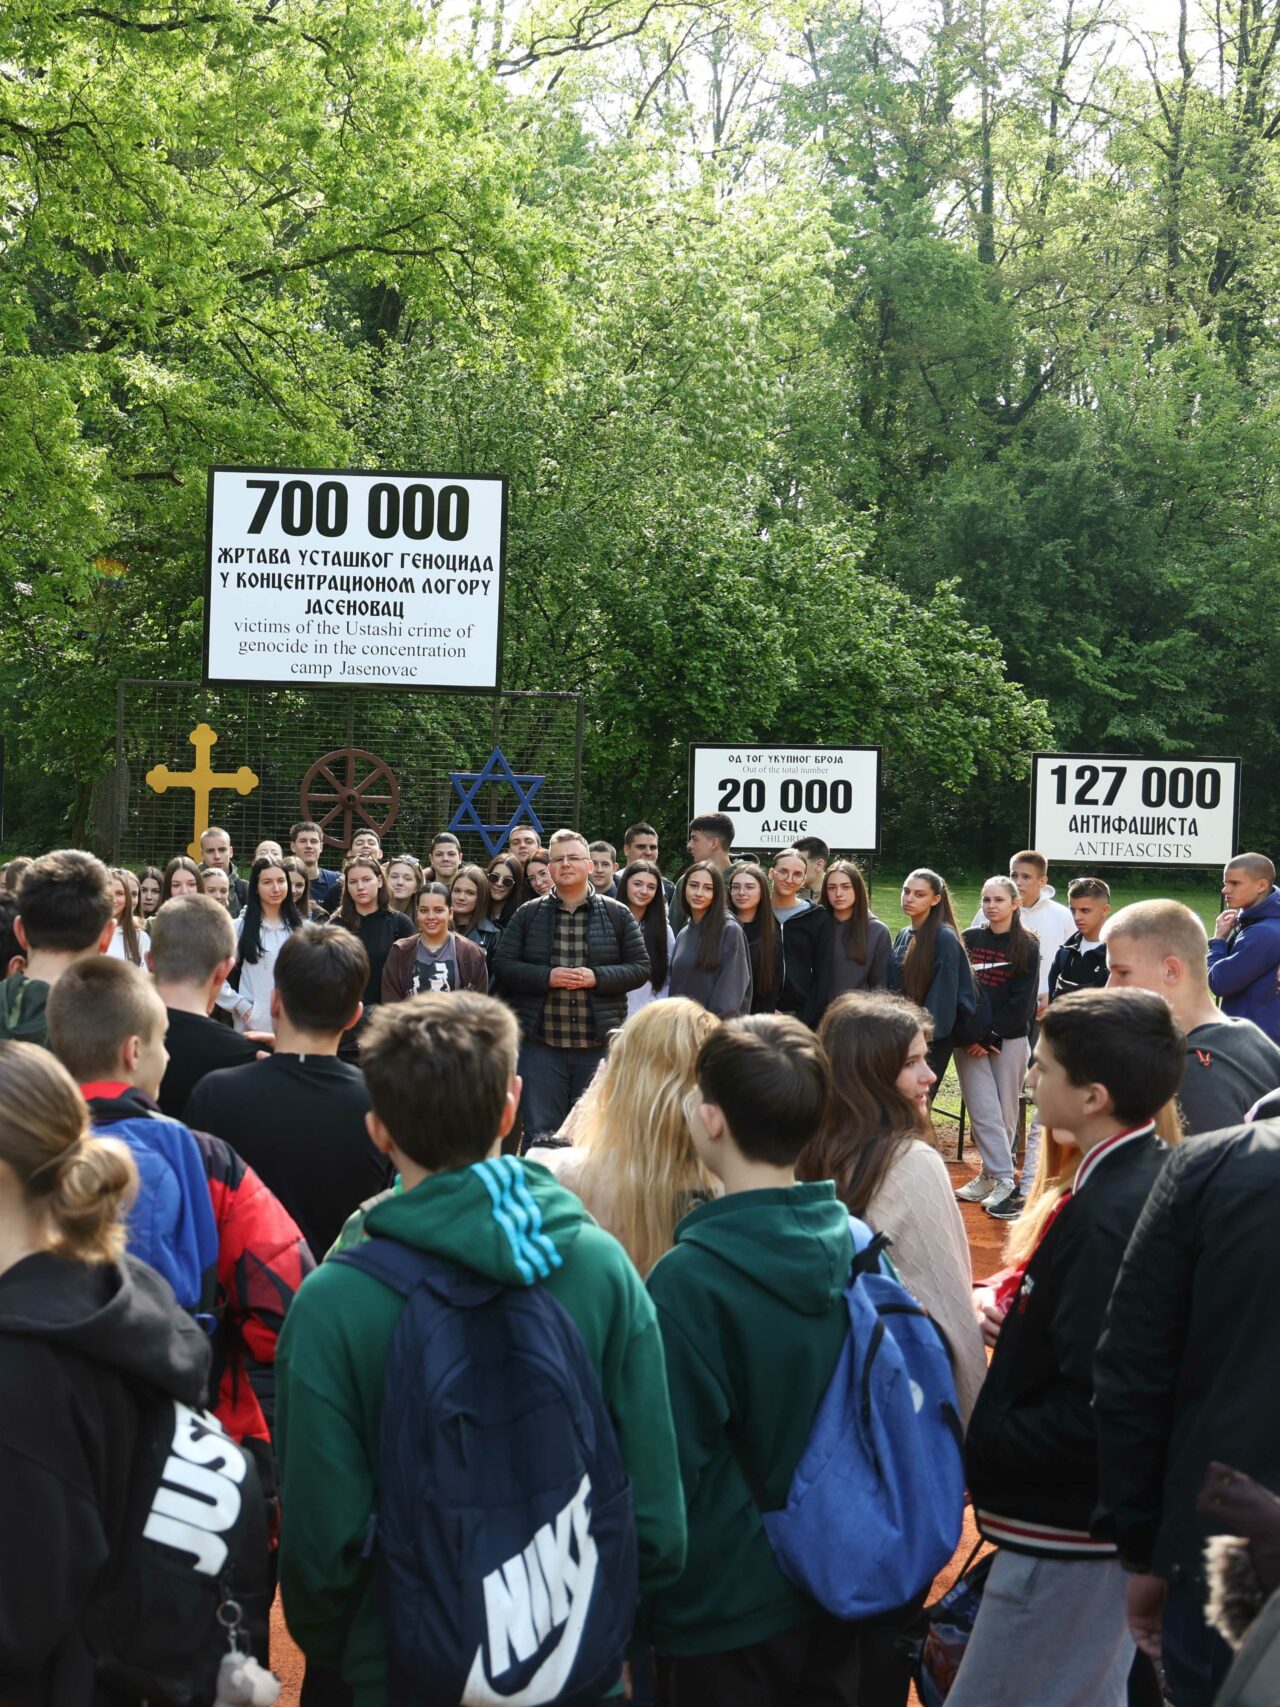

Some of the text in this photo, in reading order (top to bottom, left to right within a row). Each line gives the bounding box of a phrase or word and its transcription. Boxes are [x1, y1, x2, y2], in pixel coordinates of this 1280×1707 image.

[246, 480, 469, 541] 700 000
[218, 547, 493, 573] ЖРТАВА УСТАШКОГ ГЕНОЦИДА
[220, 572, 490, 595] У КОНЦЕНТРАЦИОНОМ ЛОГОРУ
[305, 599, 404, 619] ЈАСЕНОВАЦ
[234, 618, 475, 638] victims of the Ustashi crime of
[239, 640, 465, 657] genocide in the concentration
[291, 662, 417, 678] camp Jasenovac
[728, 754, 843, 763] ОД ТОГ УКУПНОГ БРОЈА
[741, 764, 829, 774] Out of the total number
[718, 778, 852, 814] 20 000
[1051, 765, 1221, 809] 127 000
[761, 820, 807, 833] ДЈЕЦЕ
[1069, 815, 1198, 836] АНТИФАШИСТА
[760, 834, 809, 843] CHILDRE
[1074, 841, 1191, 858] ANTIFASCISTS
